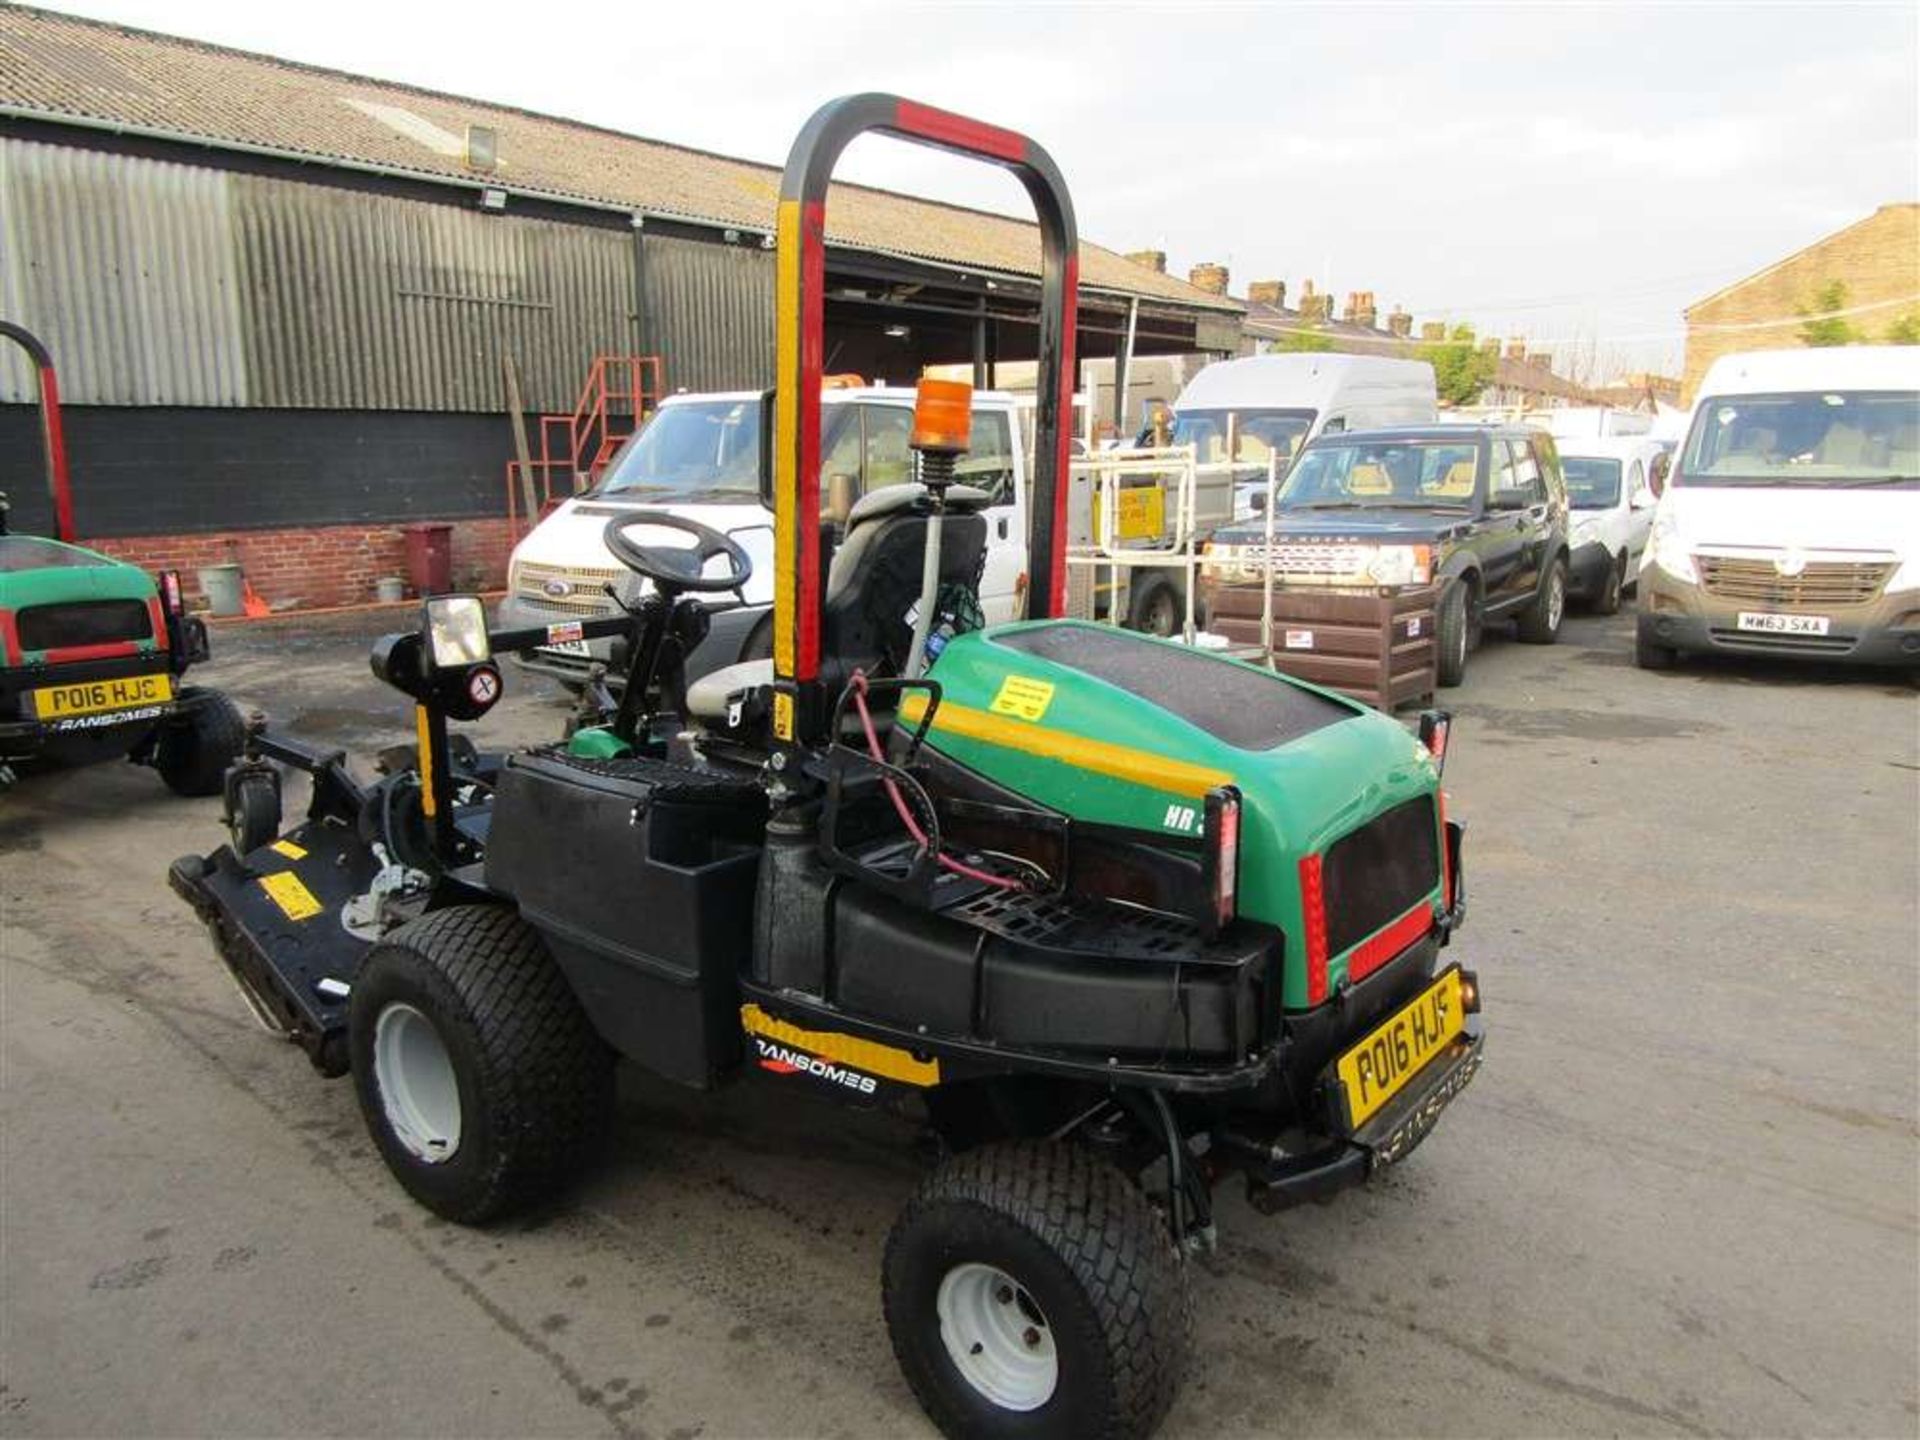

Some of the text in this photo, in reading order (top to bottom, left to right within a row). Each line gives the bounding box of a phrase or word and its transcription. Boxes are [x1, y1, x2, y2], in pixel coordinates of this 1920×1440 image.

[1744, 616, 1822, 631] MW63 SXA
[53, 687, 106, 710] PO16
[1163, 803, 1195, 831] HR
[1356, 986, 1448, 1105] PO16 HJF
